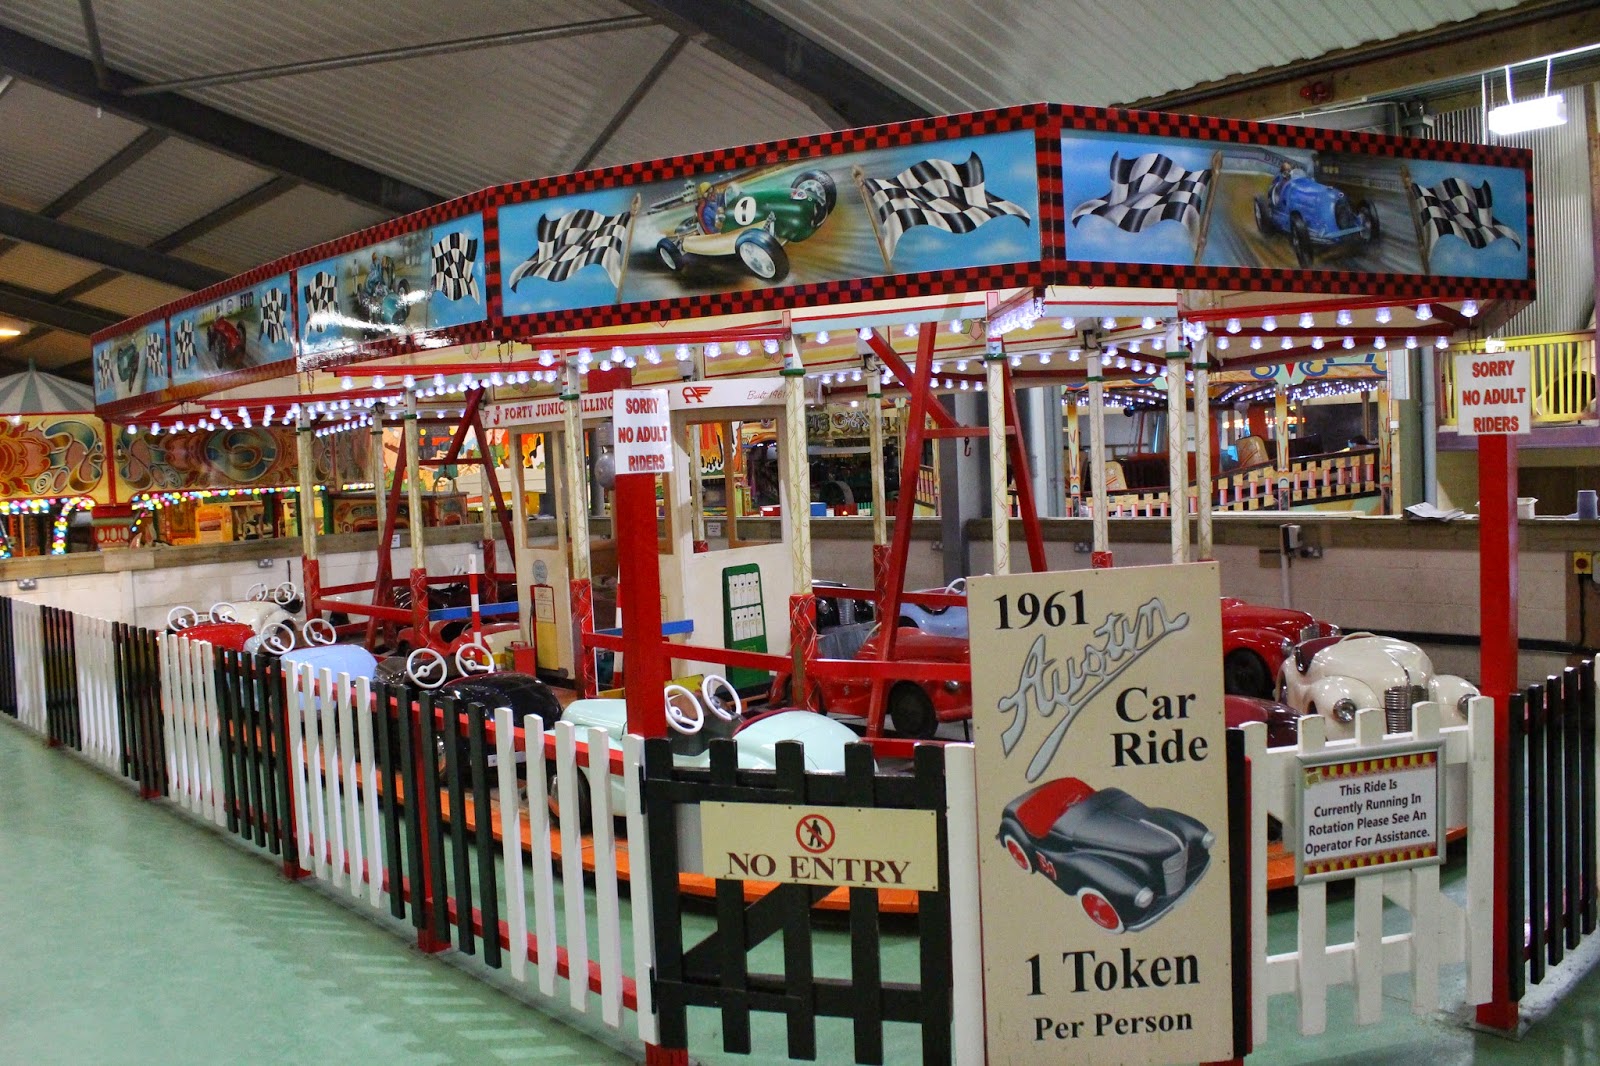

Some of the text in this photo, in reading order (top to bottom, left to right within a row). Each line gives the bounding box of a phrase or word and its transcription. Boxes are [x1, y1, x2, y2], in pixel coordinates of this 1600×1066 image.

[1472, 360, 1515, 377] SORRY
[504, 404, 534, 420] FORTY
[535, 401, 566, 417] JUNIO
[581, 397, 613, 412] ILLING
[625, 397, 659, 415] SORRY
[1462, 388, 1526, 405] NO ADULT
[618, 425, 668, 443] NO ADULT
[1473, 416, 1519, 433] RIDERS
[628, 454, 665, 471] RIDERS
[993, 590, 1090, 631] 1961
[997, 596, 1190, 783] Austin
[1116, 686, 1197, 724] Car
[1111, 727, 1209, 768] Ride
[1339, 779, 1398, 797] This Ride Is
[1314, 793, 1422, 818] Currently Running In
[1309, 810, 1427, 836] Rotation Please See An
[1305, 828, 1430, 857] Operator For Assistance.
[726, 852, 911, 884] NO ENTRY
[1025, 947, 1200, 997] 1 Token
[1034, 1012, 1193, 1041] Per Person
